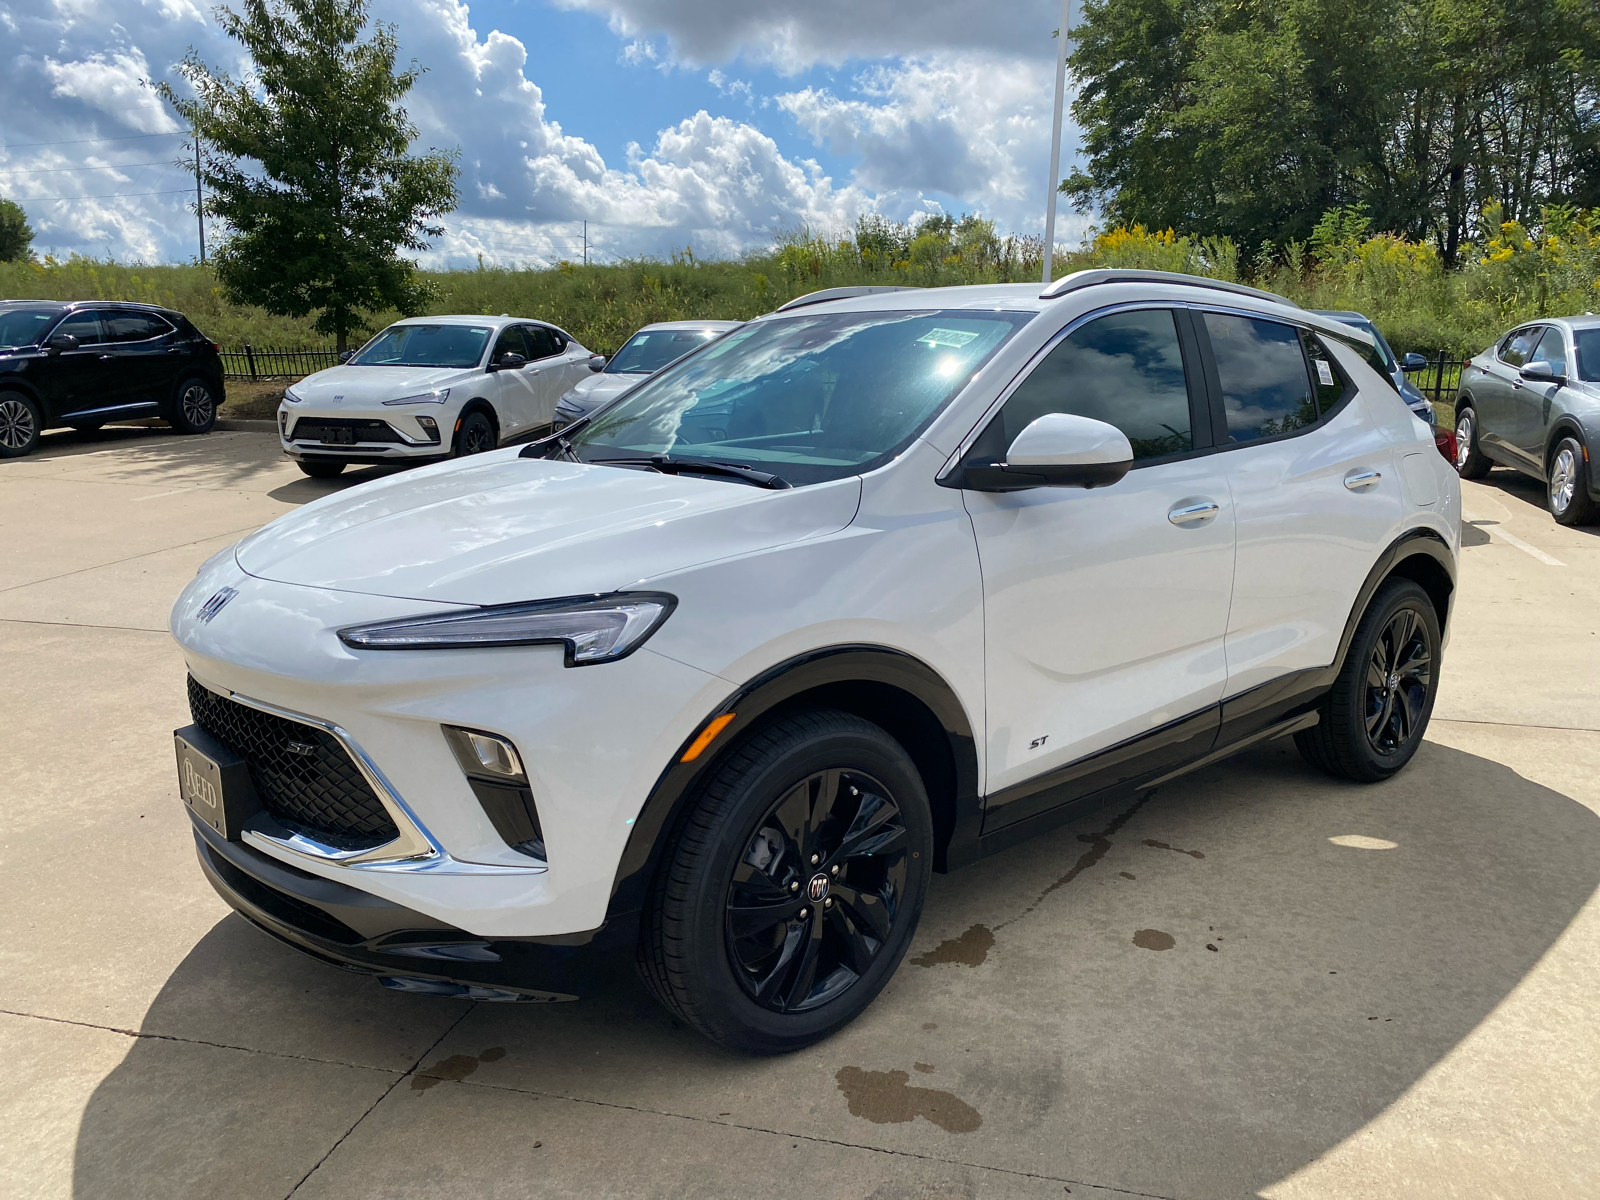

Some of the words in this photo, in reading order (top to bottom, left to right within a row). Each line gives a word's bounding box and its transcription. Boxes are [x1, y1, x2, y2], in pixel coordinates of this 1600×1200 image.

[287, 741, 314, 756] ST
[1028, 735, 1049, 750] ST
[183, 757, 217, 809] REED
